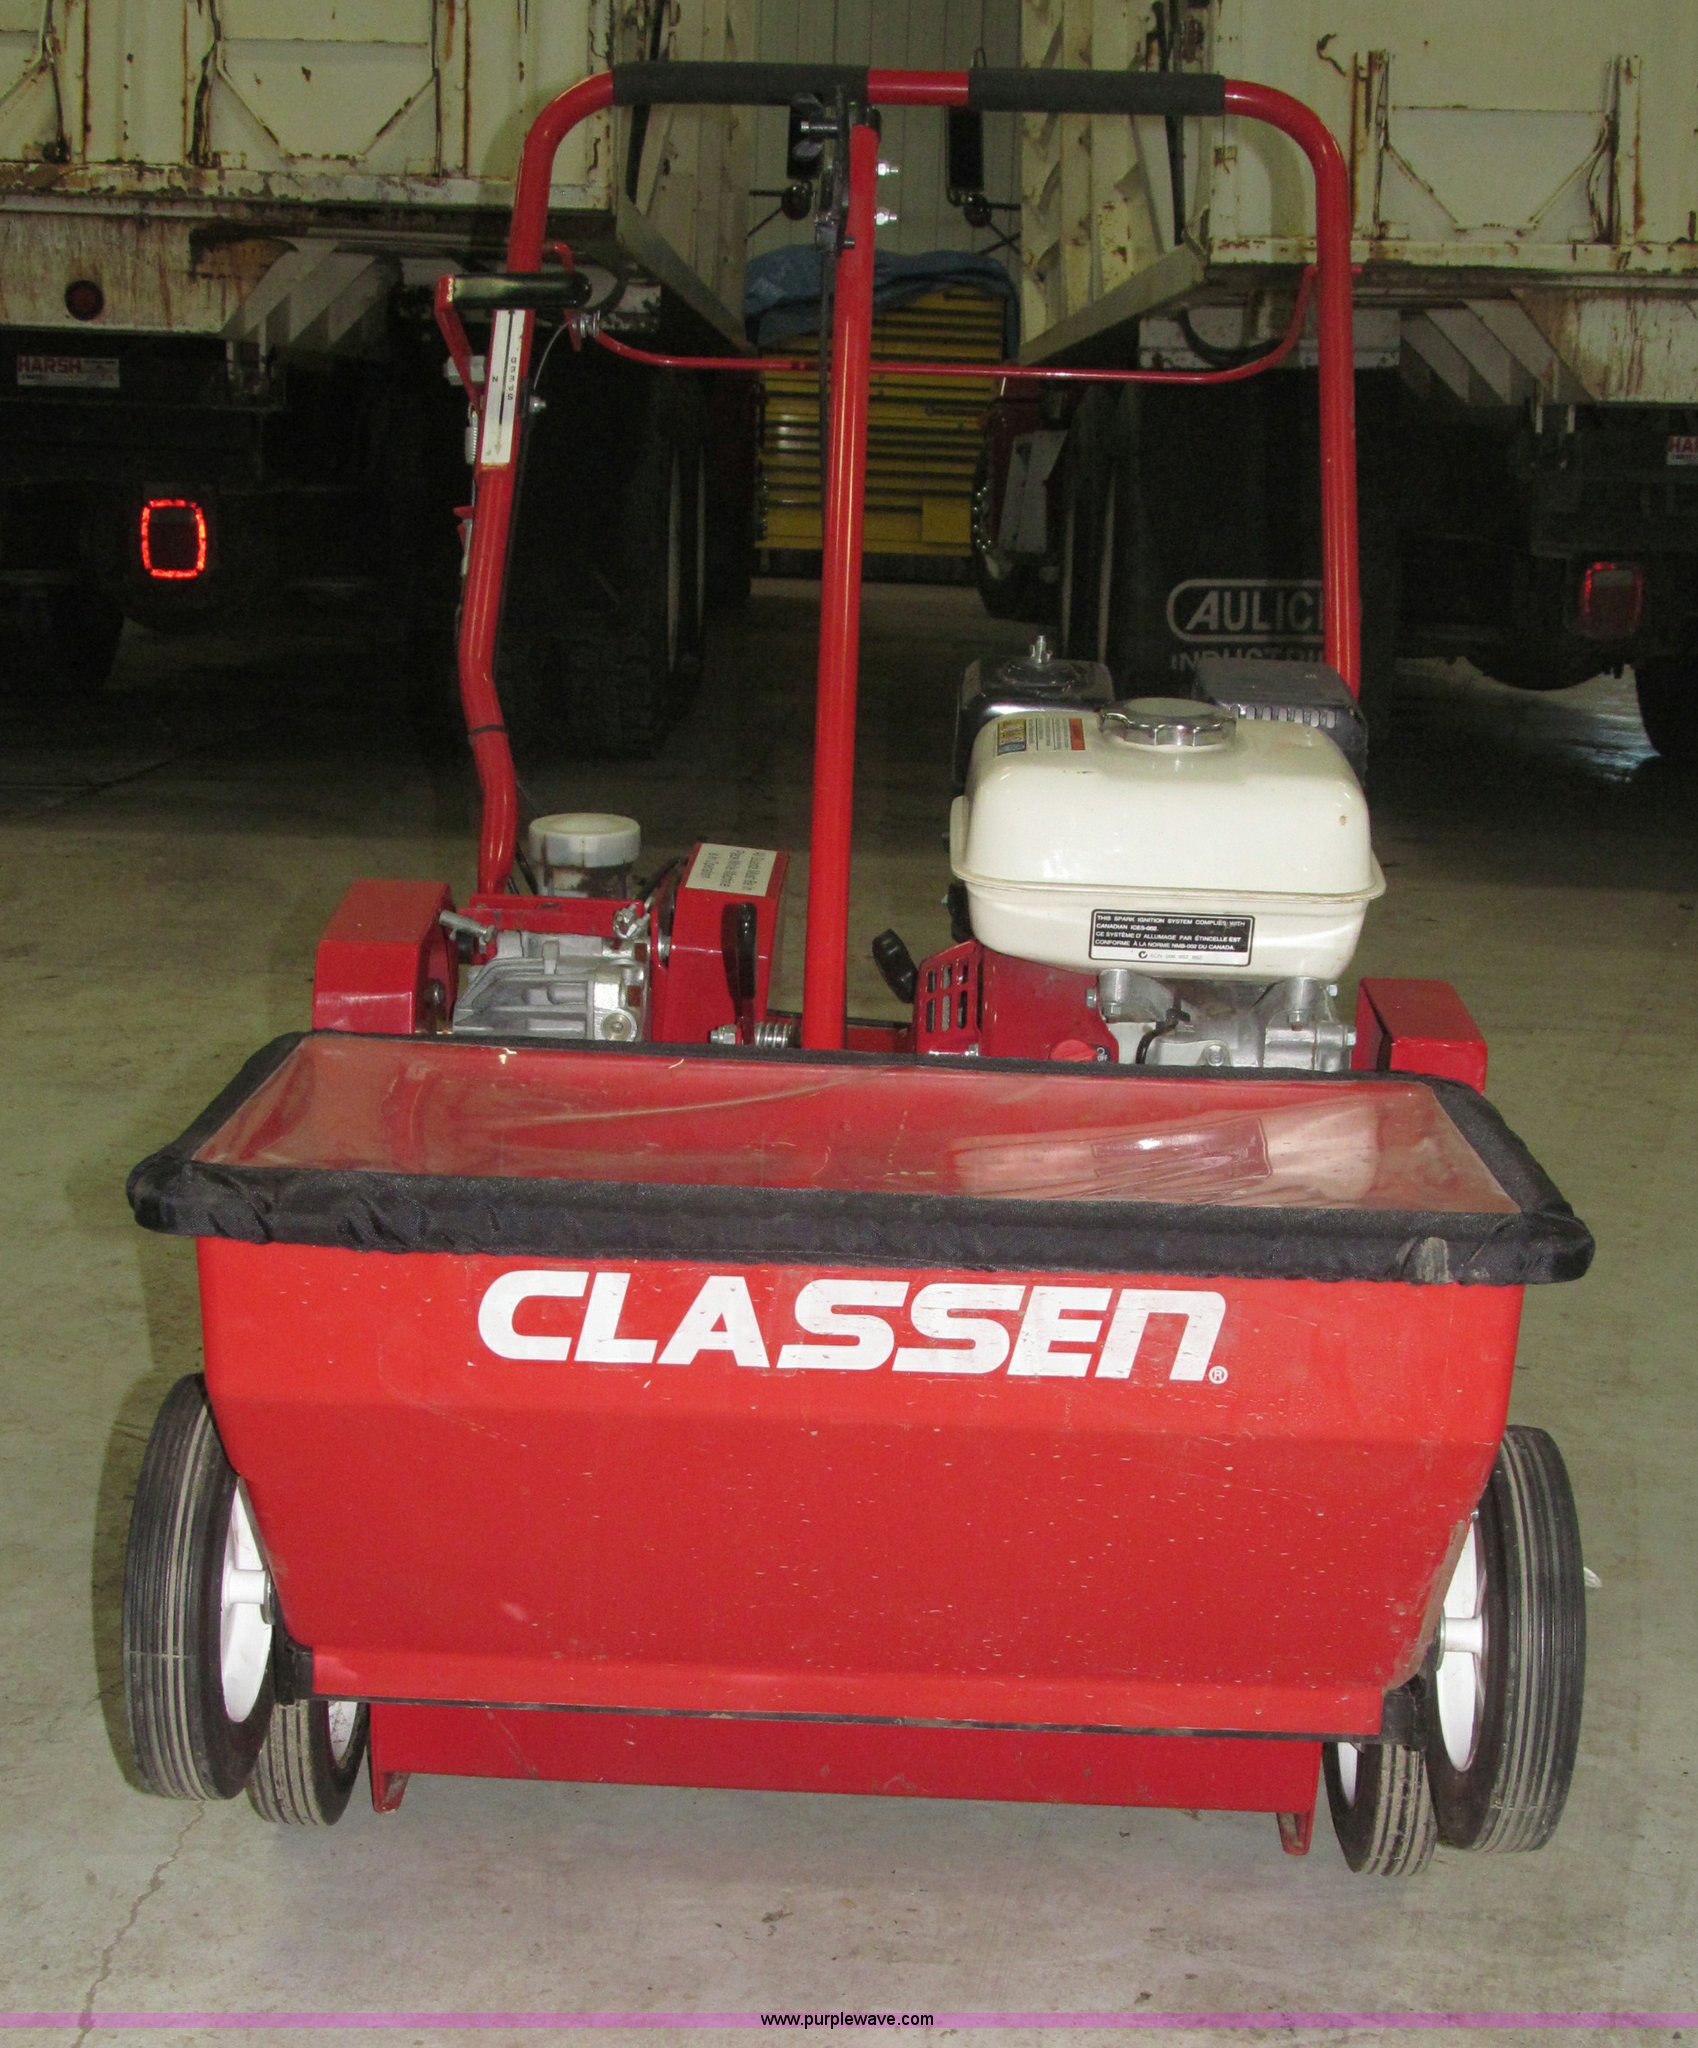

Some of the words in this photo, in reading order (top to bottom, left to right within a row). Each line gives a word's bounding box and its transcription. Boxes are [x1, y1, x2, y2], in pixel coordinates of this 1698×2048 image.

[1667, 436, 1698, 453] HA
[1186, 590, 1324, 632] AULIC
[478, 1269, 1227, 1382] CLASSEN
